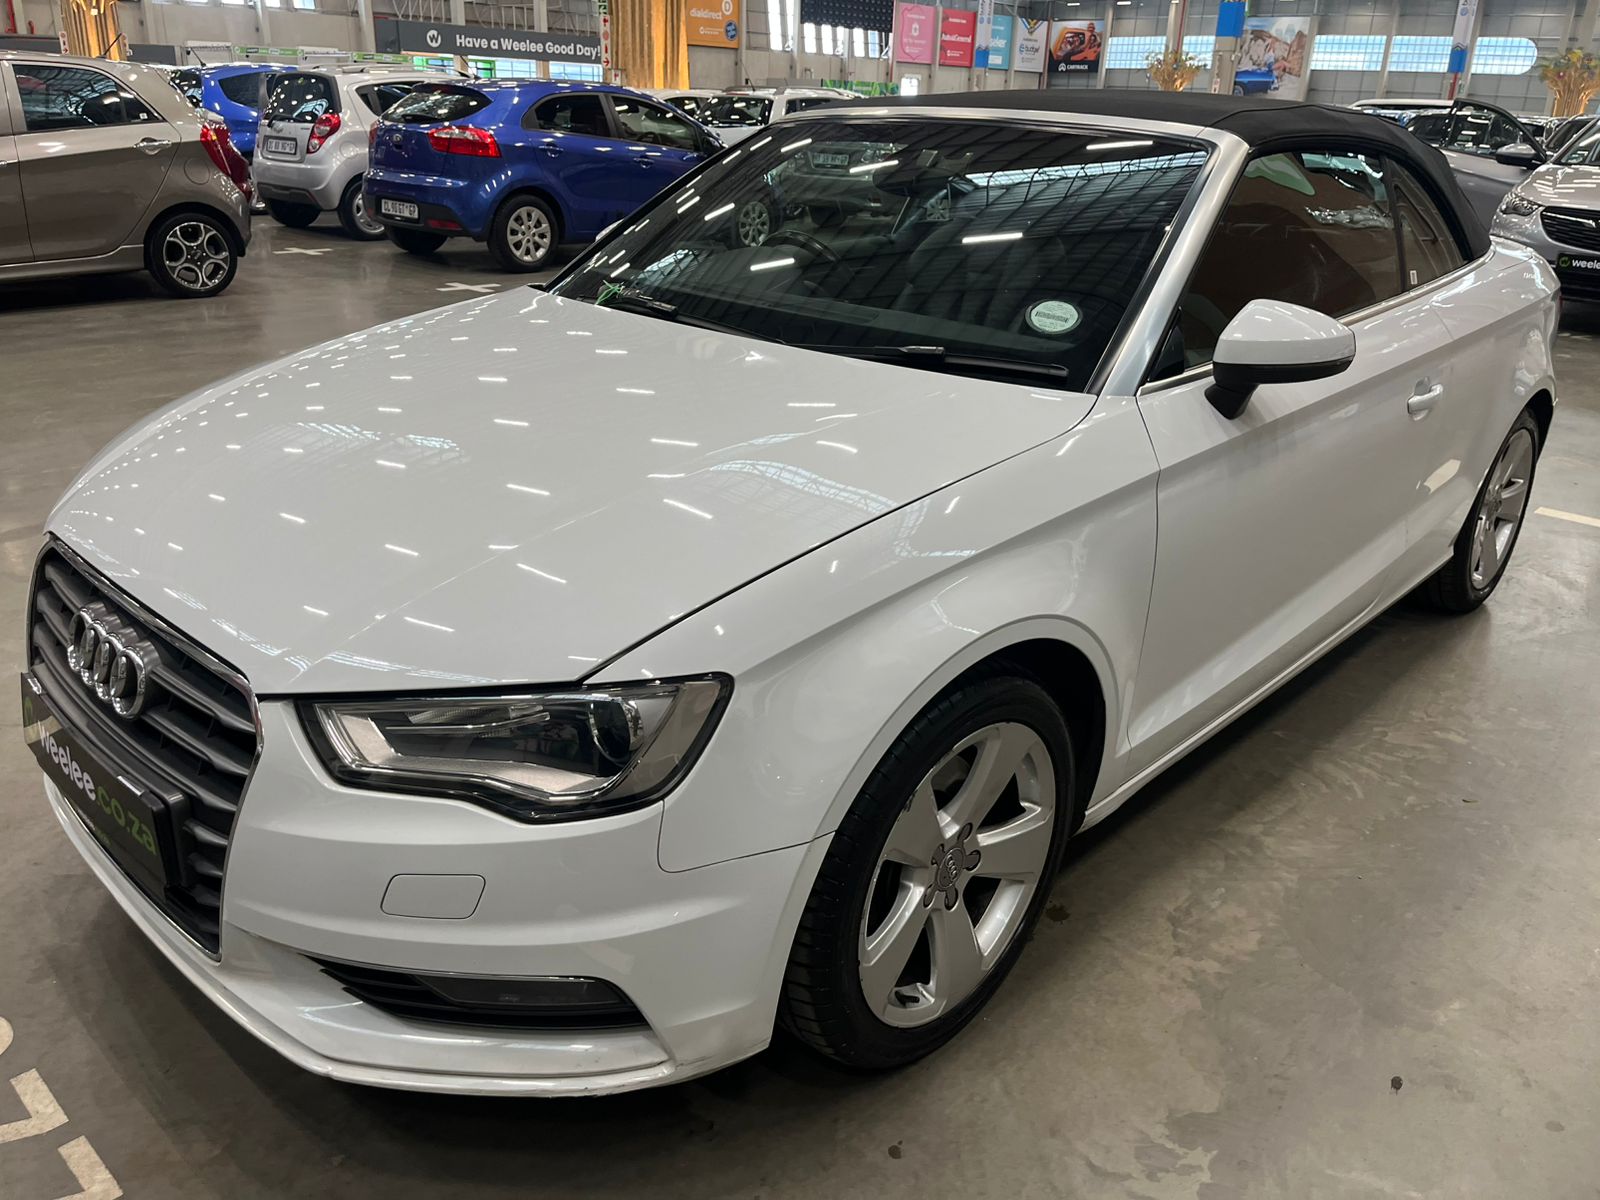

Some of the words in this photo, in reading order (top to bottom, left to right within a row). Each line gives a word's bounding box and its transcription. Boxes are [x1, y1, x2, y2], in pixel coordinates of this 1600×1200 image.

[456, 34, 488, 49] Have
[490, 40, 499, 49] a
[501, 38, 544, 52] Weelee
[545, 43, 574, 54] Good
[576, 45, 601, 60] Day!
